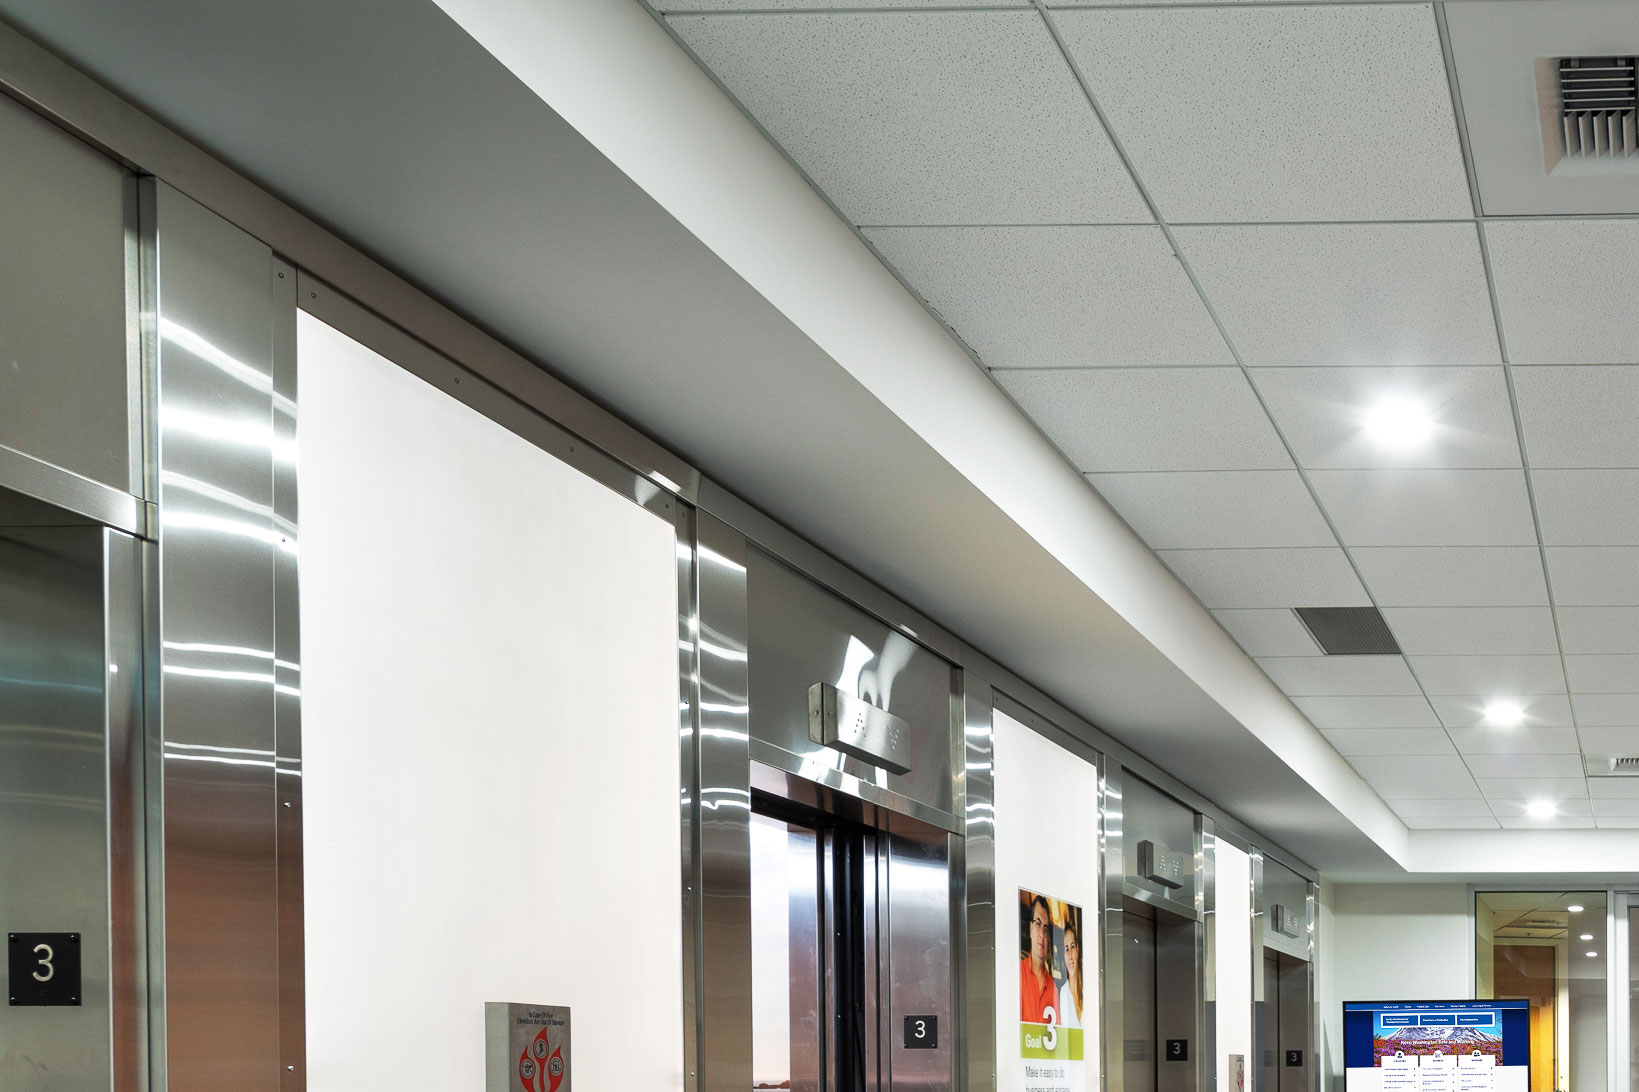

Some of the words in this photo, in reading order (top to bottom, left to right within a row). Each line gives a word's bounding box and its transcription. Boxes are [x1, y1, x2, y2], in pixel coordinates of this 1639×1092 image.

[33, 944, 54, 982] 3
[914, 1020, 926, 1038] 3
[1025, 1034, 1042, 1048] Goal
[1043, 1005, 1057, 1051] 3
[1173, 1042, 1181, 1055] 3
[1291, 1052, 1298, 1062] 3
[1025, 1066, 1038, 1078] Make
[1043, 1068, 1053, 1080] easy
